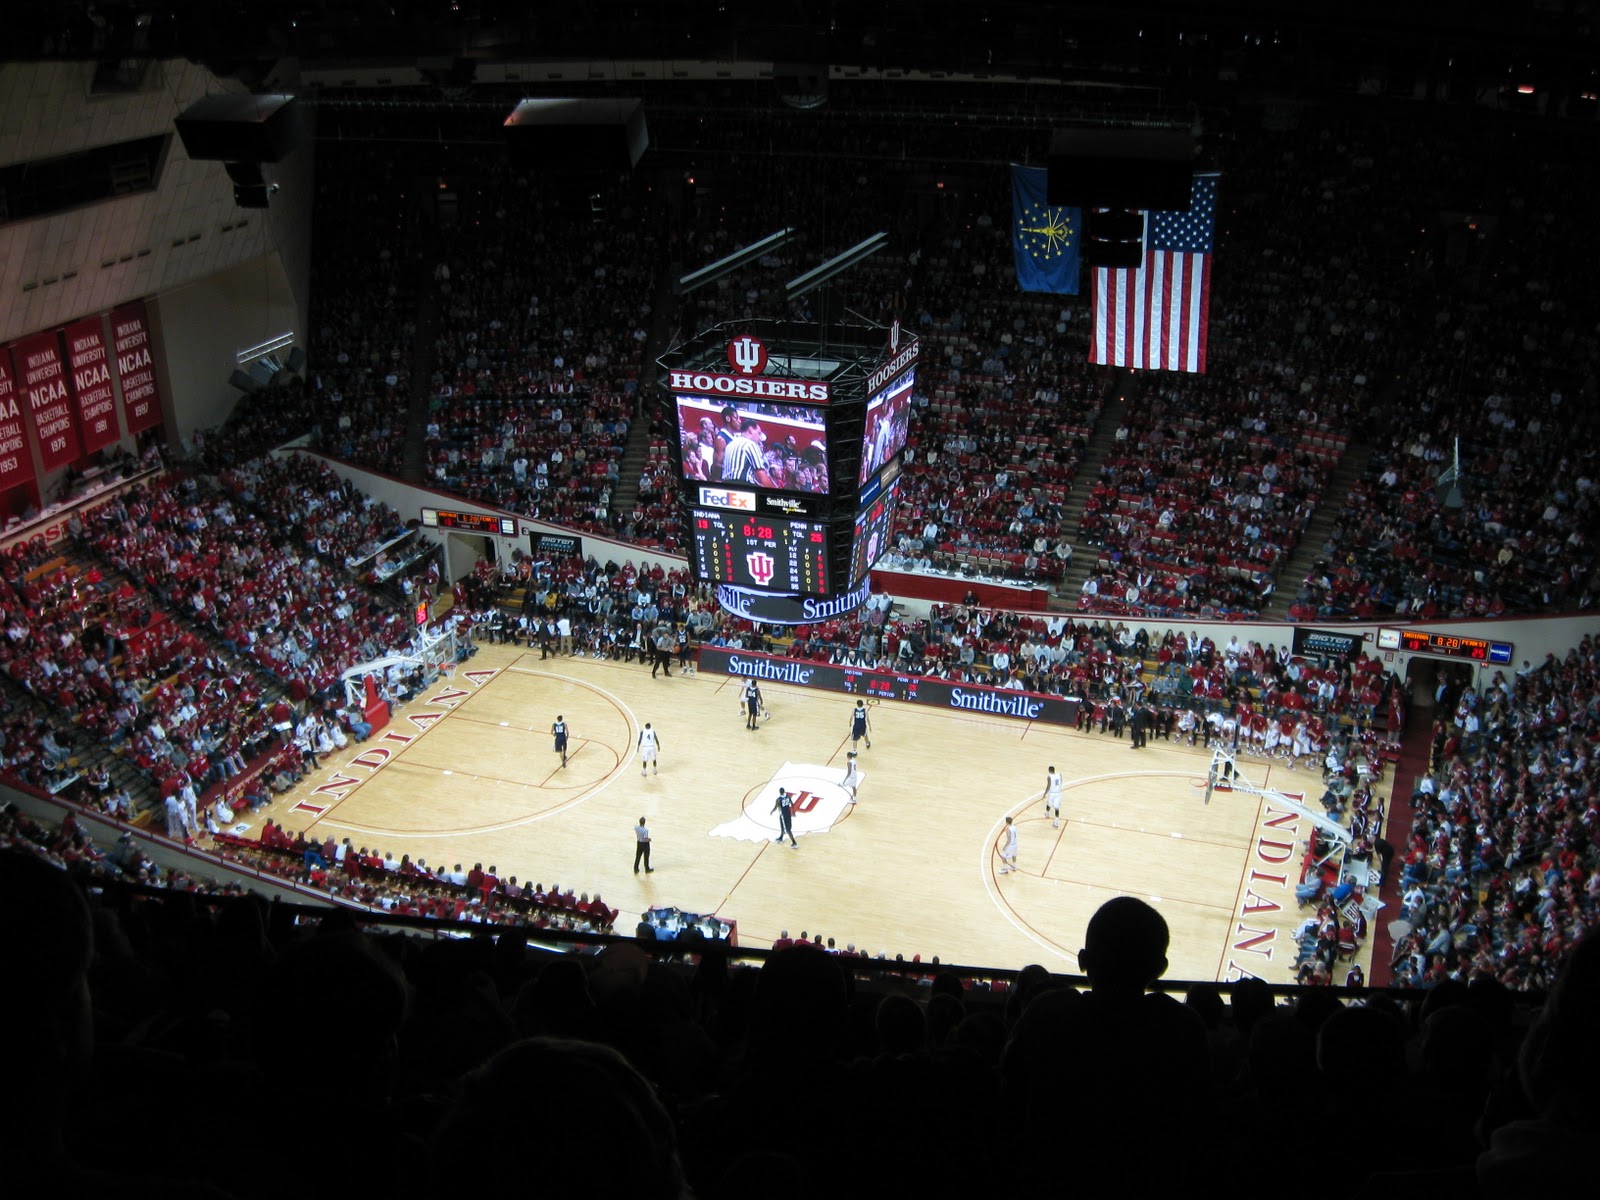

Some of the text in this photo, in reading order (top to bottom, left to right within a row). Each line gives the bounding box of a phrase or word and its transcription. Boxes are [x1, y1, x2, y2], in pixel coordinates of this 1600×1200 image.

[116, 320, 142, 337] INDIANA
[73, 334, 100, 352] INDIANA
[116, 331, 147, 352] UNIVERSITY
[28, 350, 56, 369] INDIANA
[72, 347, 106, 368] UNIVERSITY
[118, 348, 151, 375] NCAA
[868, 342, 919, 394] HOOSIERS
[26, 362, 62, 384] UNIVERSITY
[75, 364, 111, 392] NCAA
[122, 370, 154, 392] BASKETBALL
[29, 380, 68, 409] NCAA
[80, 386, 112, 408] BASKETBALL
[125, 383, 155, 404] CHAMPIONS
[671, 373, 828, 400] HOOSIERS
[0, 398, 20, 421] AA
[35, 403, 70, 426] BASKETBALL
[84, 400, 113, 421] CHAMPIONS
[134, 402, 148, 418] 1987
[0, 422, 22, 440] ETBALL
[39, 417, 70, 439] CHAMPIONS
[94, 419, 108, 434] 1981
[51, 437, 66, 453] 1976
[0, 457, 18, 474] 1953
[703, 490, 747, 508] FedEx
[766, 498, 800, 509] Smithville
[743, 525, 772, 539] 8:28
[810, 533, 823, 542] 25
[803, 574, 870, 619] Smithvill
[1437, 637, 1458, 647] 8:28
[1472, 648, 1484, 658] 25
[729, 655, 810, 684] Smithville
[951, 688, 1039, 718] Smithville
[288, 668, 500, 818] INDIANA
